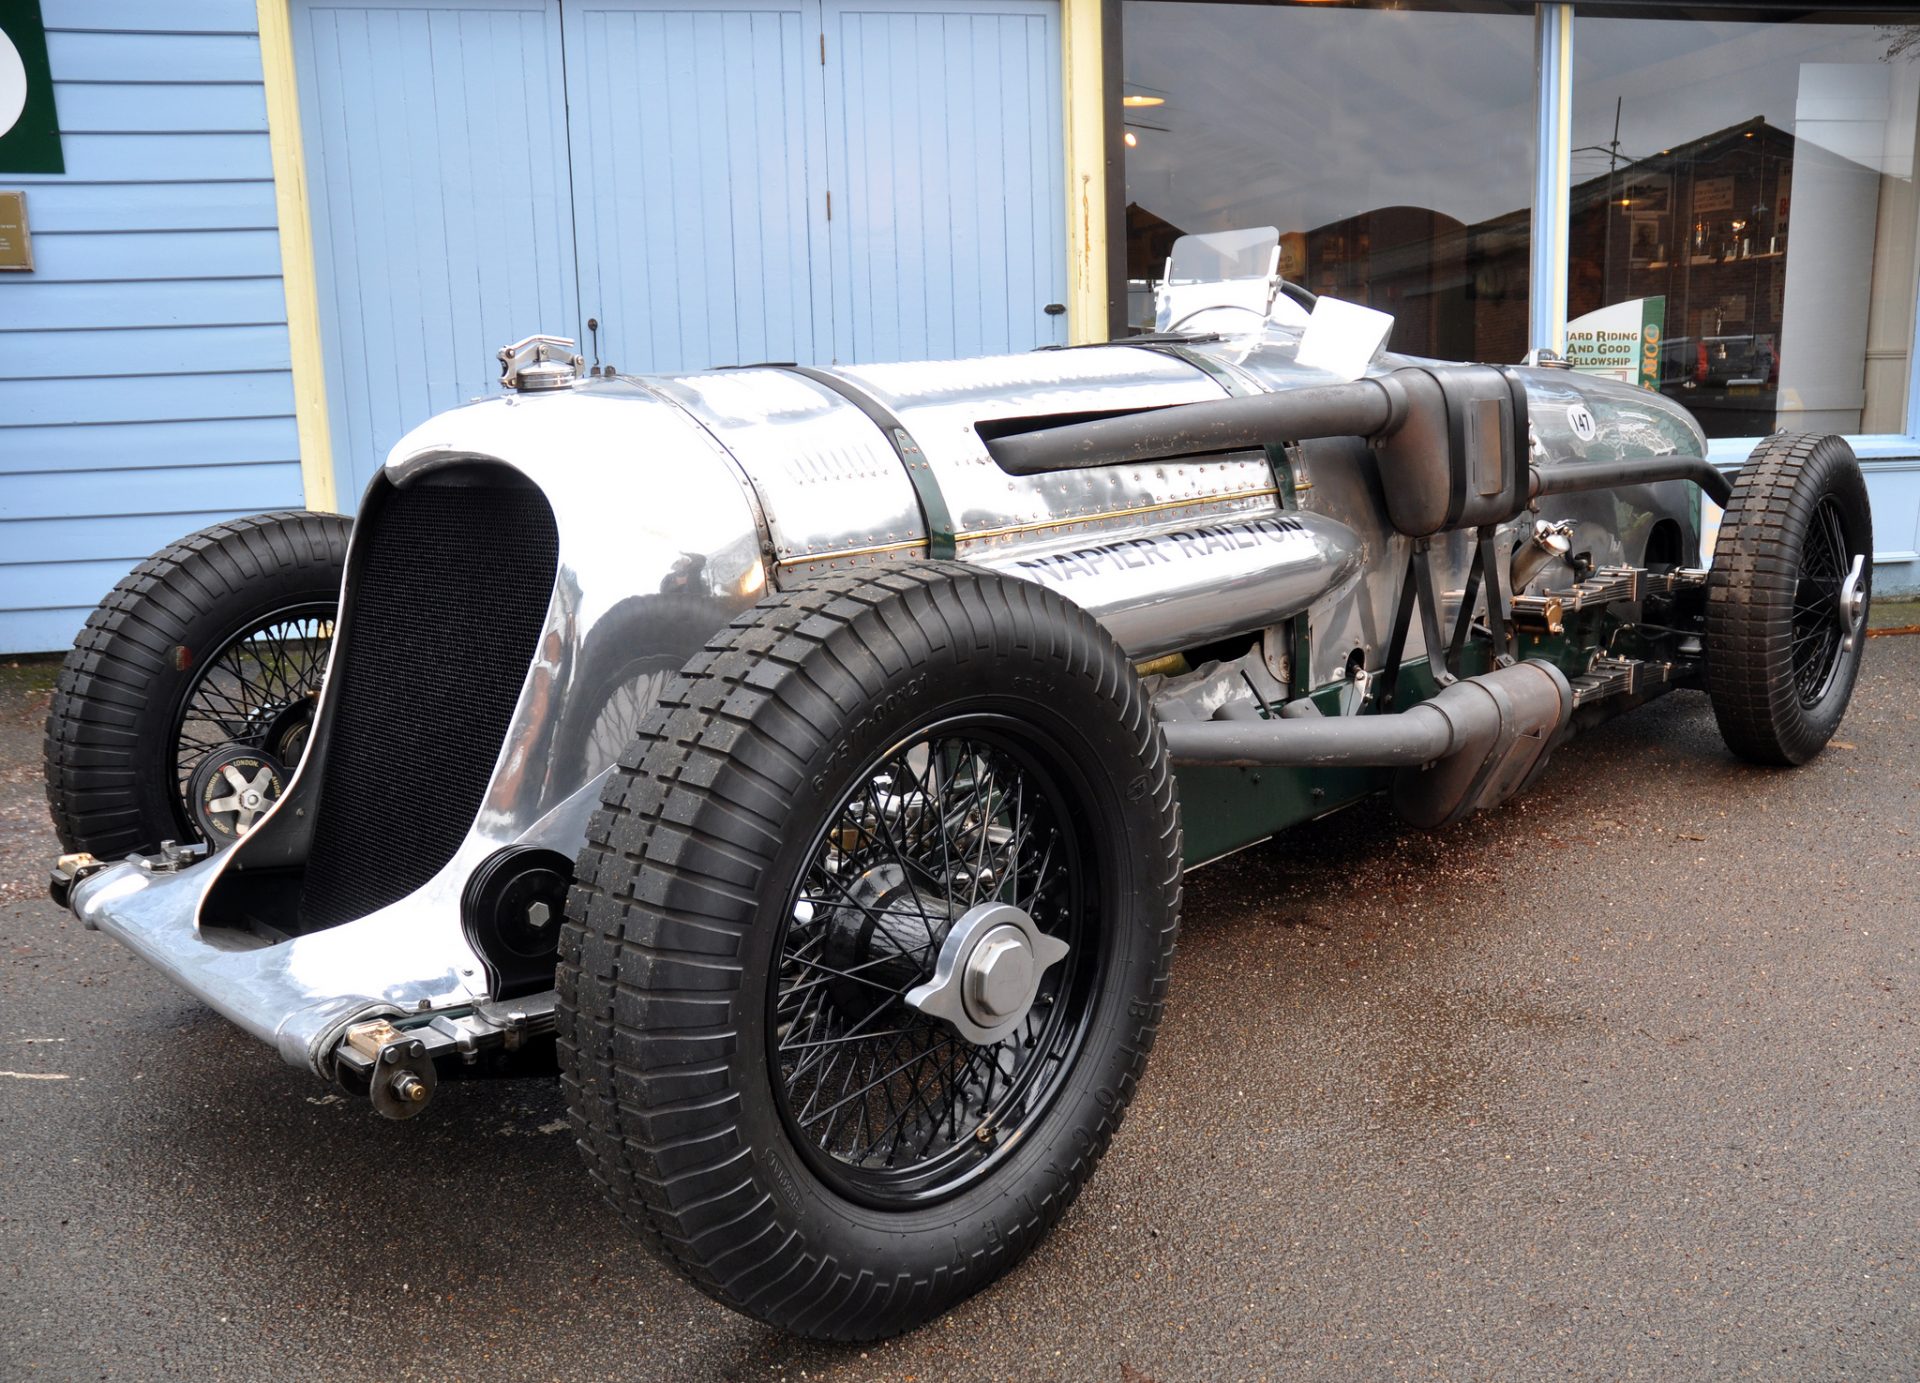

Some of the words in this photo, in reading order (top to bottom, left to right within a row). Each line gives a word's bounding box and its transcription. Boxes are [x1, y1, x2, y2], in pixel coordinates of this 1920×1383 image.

[1596, 331, 1638, 342] RIDING
[1566, 343, 1594, 354] AND
[1597, 343, 1631, 355] GOOD
[1566, 356, 1631, 366] FELLOWSHIP
[1571, 413, 1590, 432] 147
